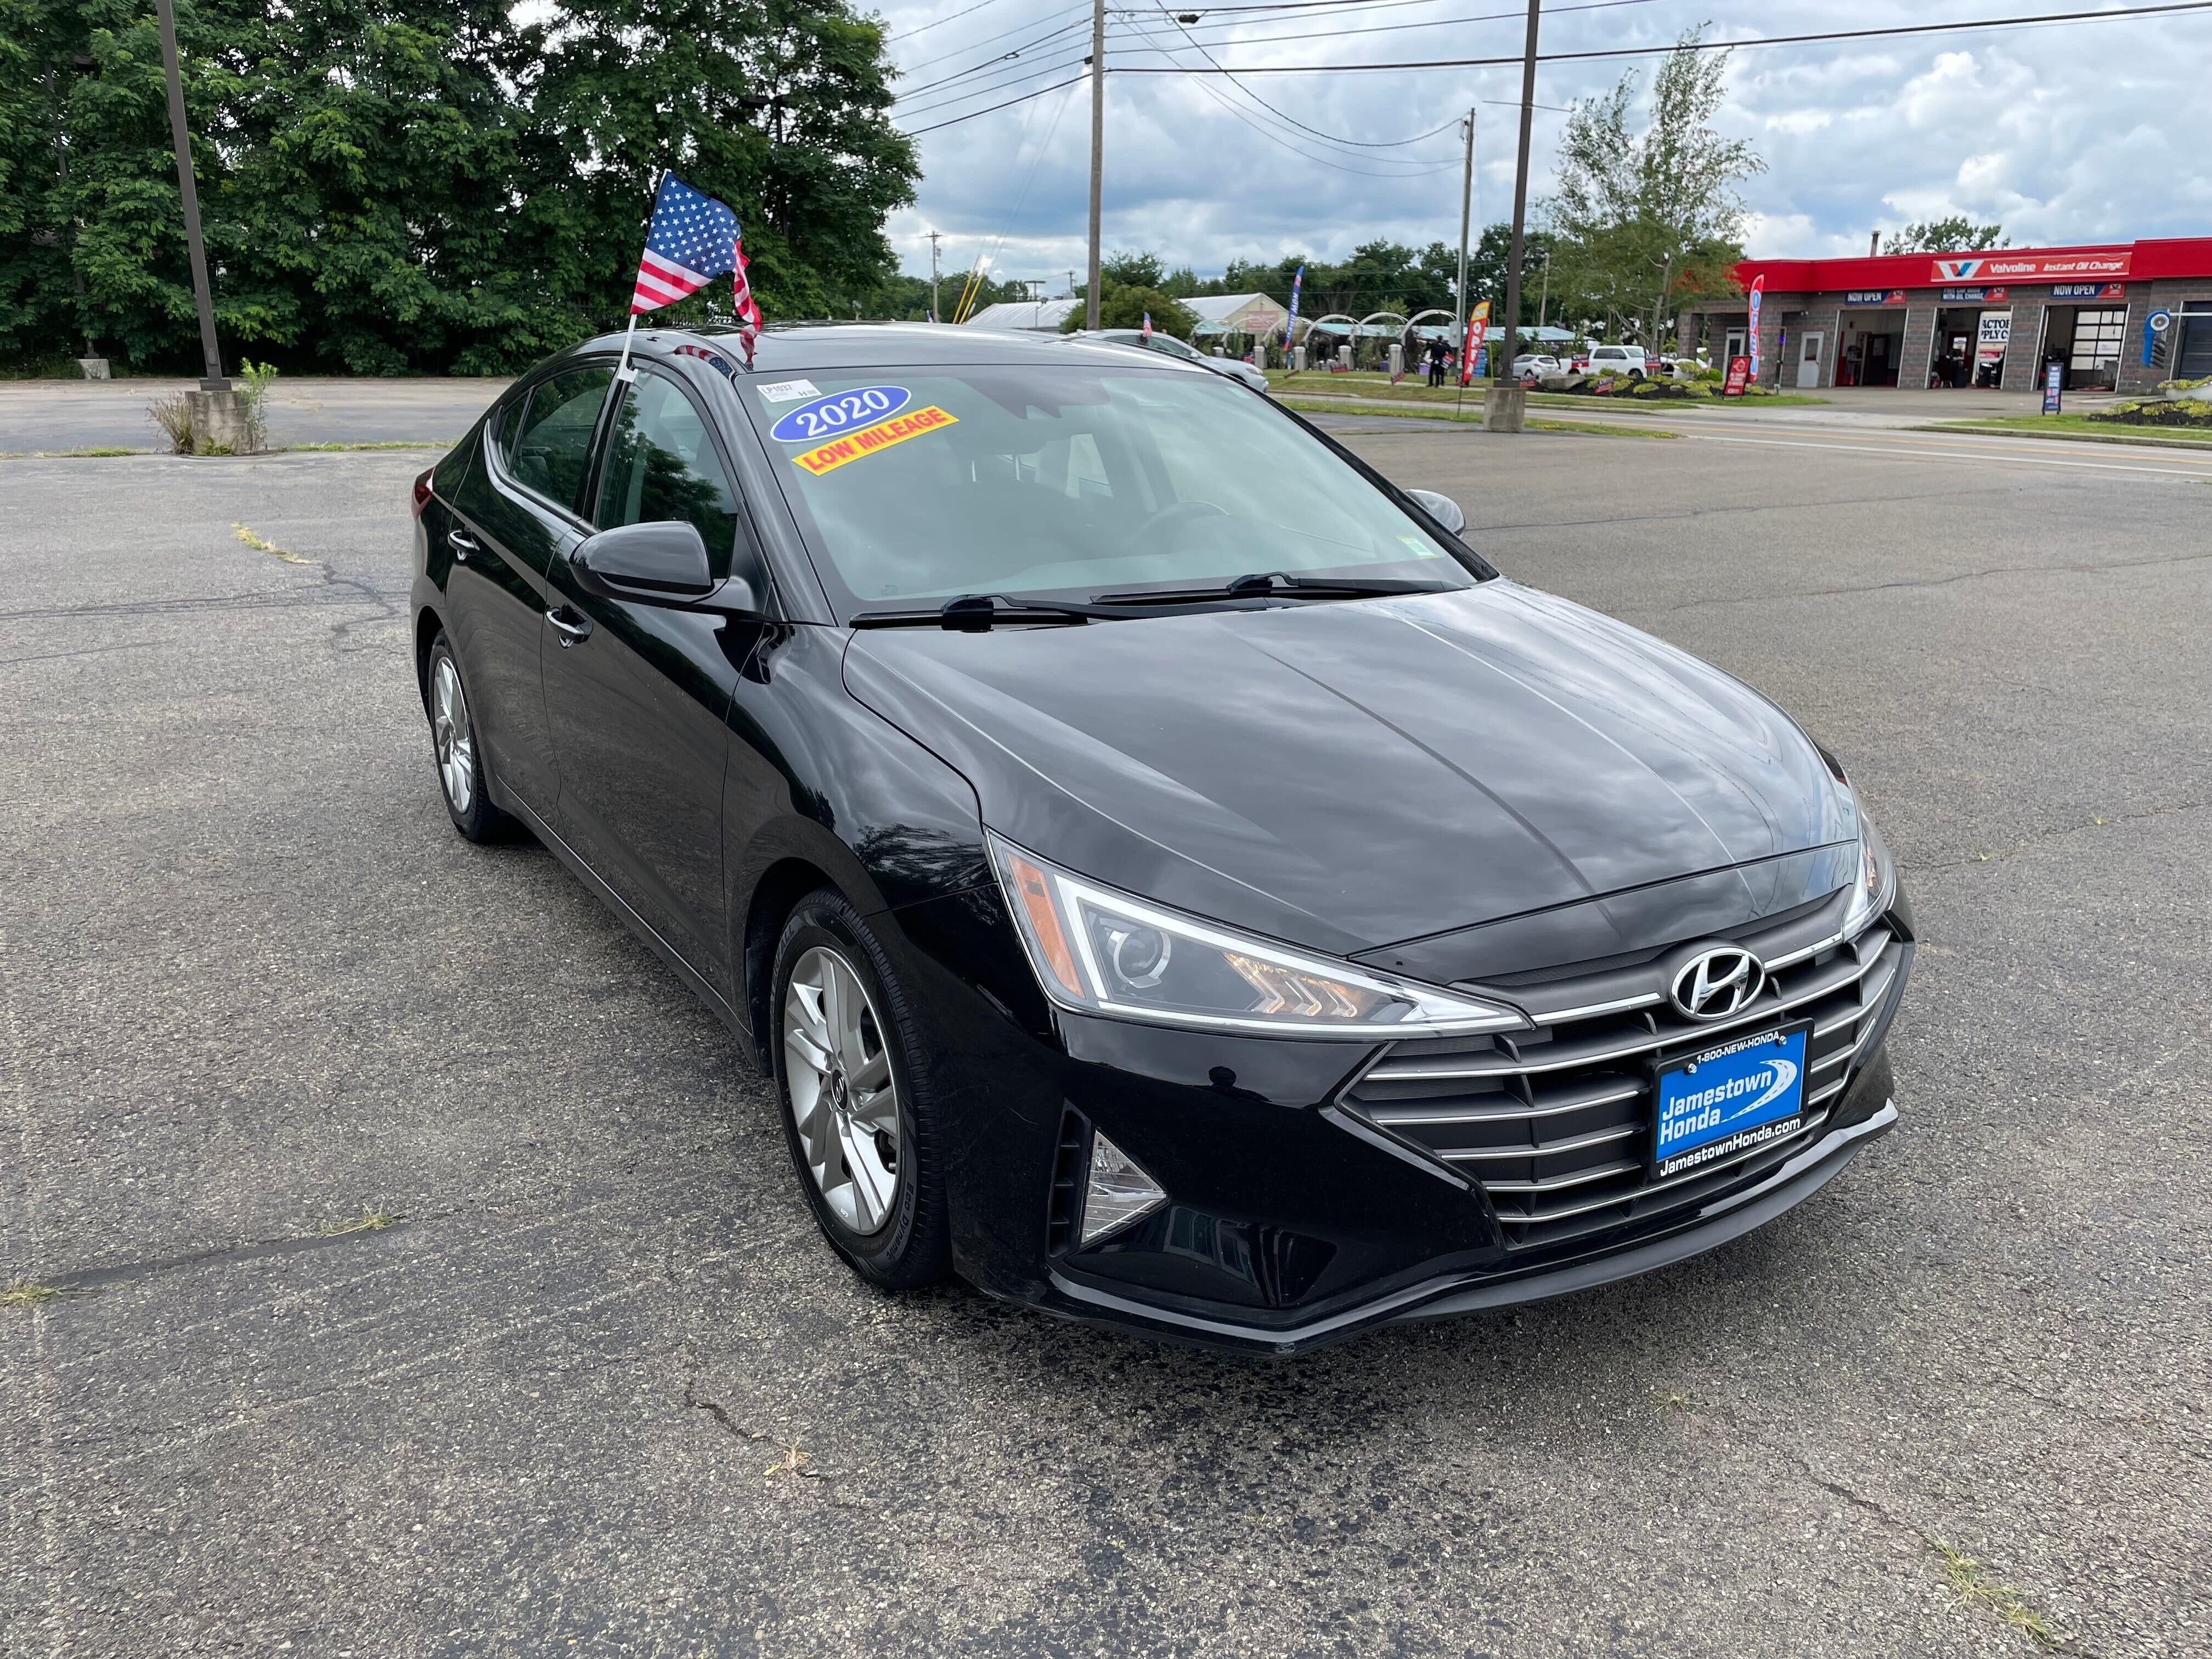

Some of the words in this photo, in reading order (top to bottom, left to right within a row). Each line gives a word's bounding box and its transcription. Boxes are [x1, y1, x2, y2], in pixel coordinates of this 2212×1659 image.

[1990, 262, 2036, 273] Valvoline
[2043, 262, 2075, 272] Instant
[2076, 261, 2087, 270] Oil
[2089, 261, 2124, 271] Change
[1847, 292, 1863, 302] NOW
[1864, 292, 1882, 302] OPEN
[2053, 285, 2072, 295] NOW
[2074, 285, 2095, 295] OPEN
[2001, 330, 2008, 339] C
[795, 390, 890, 437] 2020
[803, 441, 855, 471] LOW
[859, 409, 946, 449] MILEAGE
[1696, 1031, 1780, 1064] 1-800-NEW-HONDA
[1662, 1070, 1772, 1121] Jamestown
[1660, 1107, 1720, 1146] Honda
[1660, 1118, 1801, 1177] JamestownHonda.com
[904, 1180, 914, 1211] Eco
[886, 1214, 909, 1260] Dynamic
